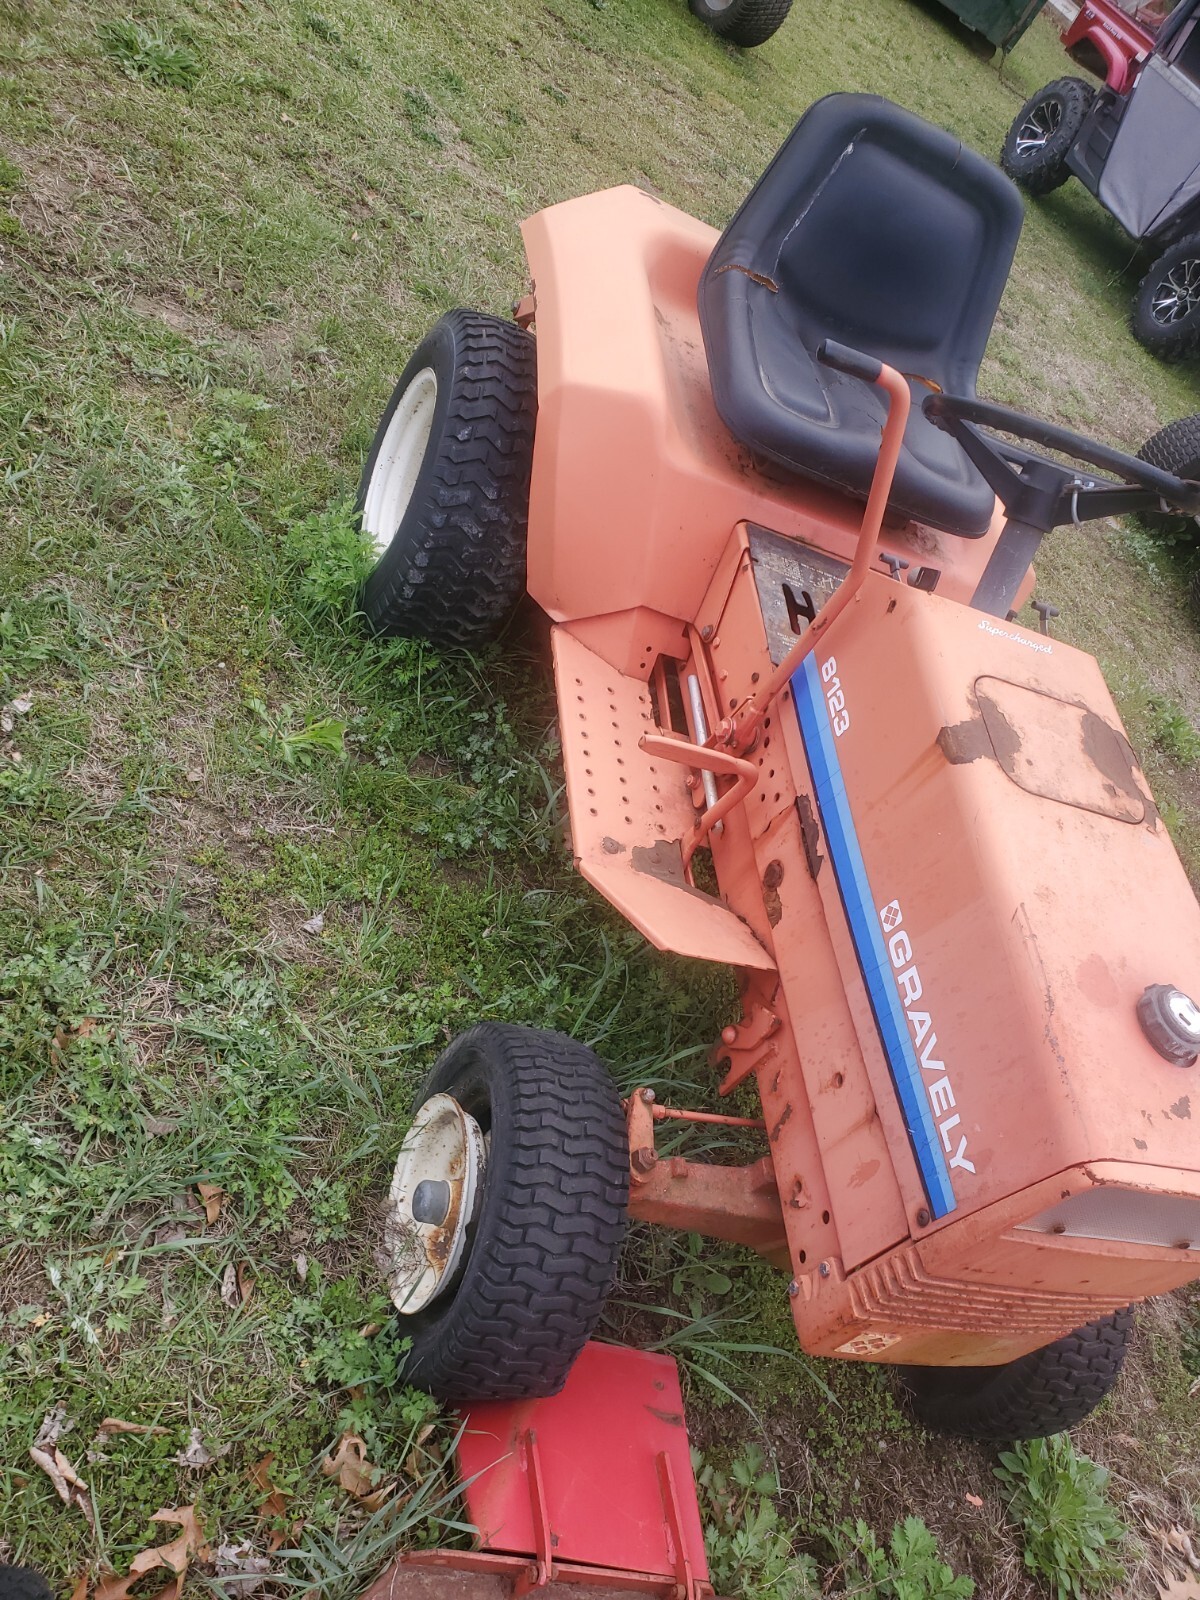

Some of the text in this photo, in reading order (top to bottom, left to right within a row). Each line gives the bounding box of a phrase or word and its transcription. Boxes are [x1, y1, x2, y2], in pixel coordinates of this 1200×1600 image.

[978, 620, 1053, 654] Supercharged
[821, 656, 850, 737] 8123
[887, 929, 976, 1174] GRAVELY
